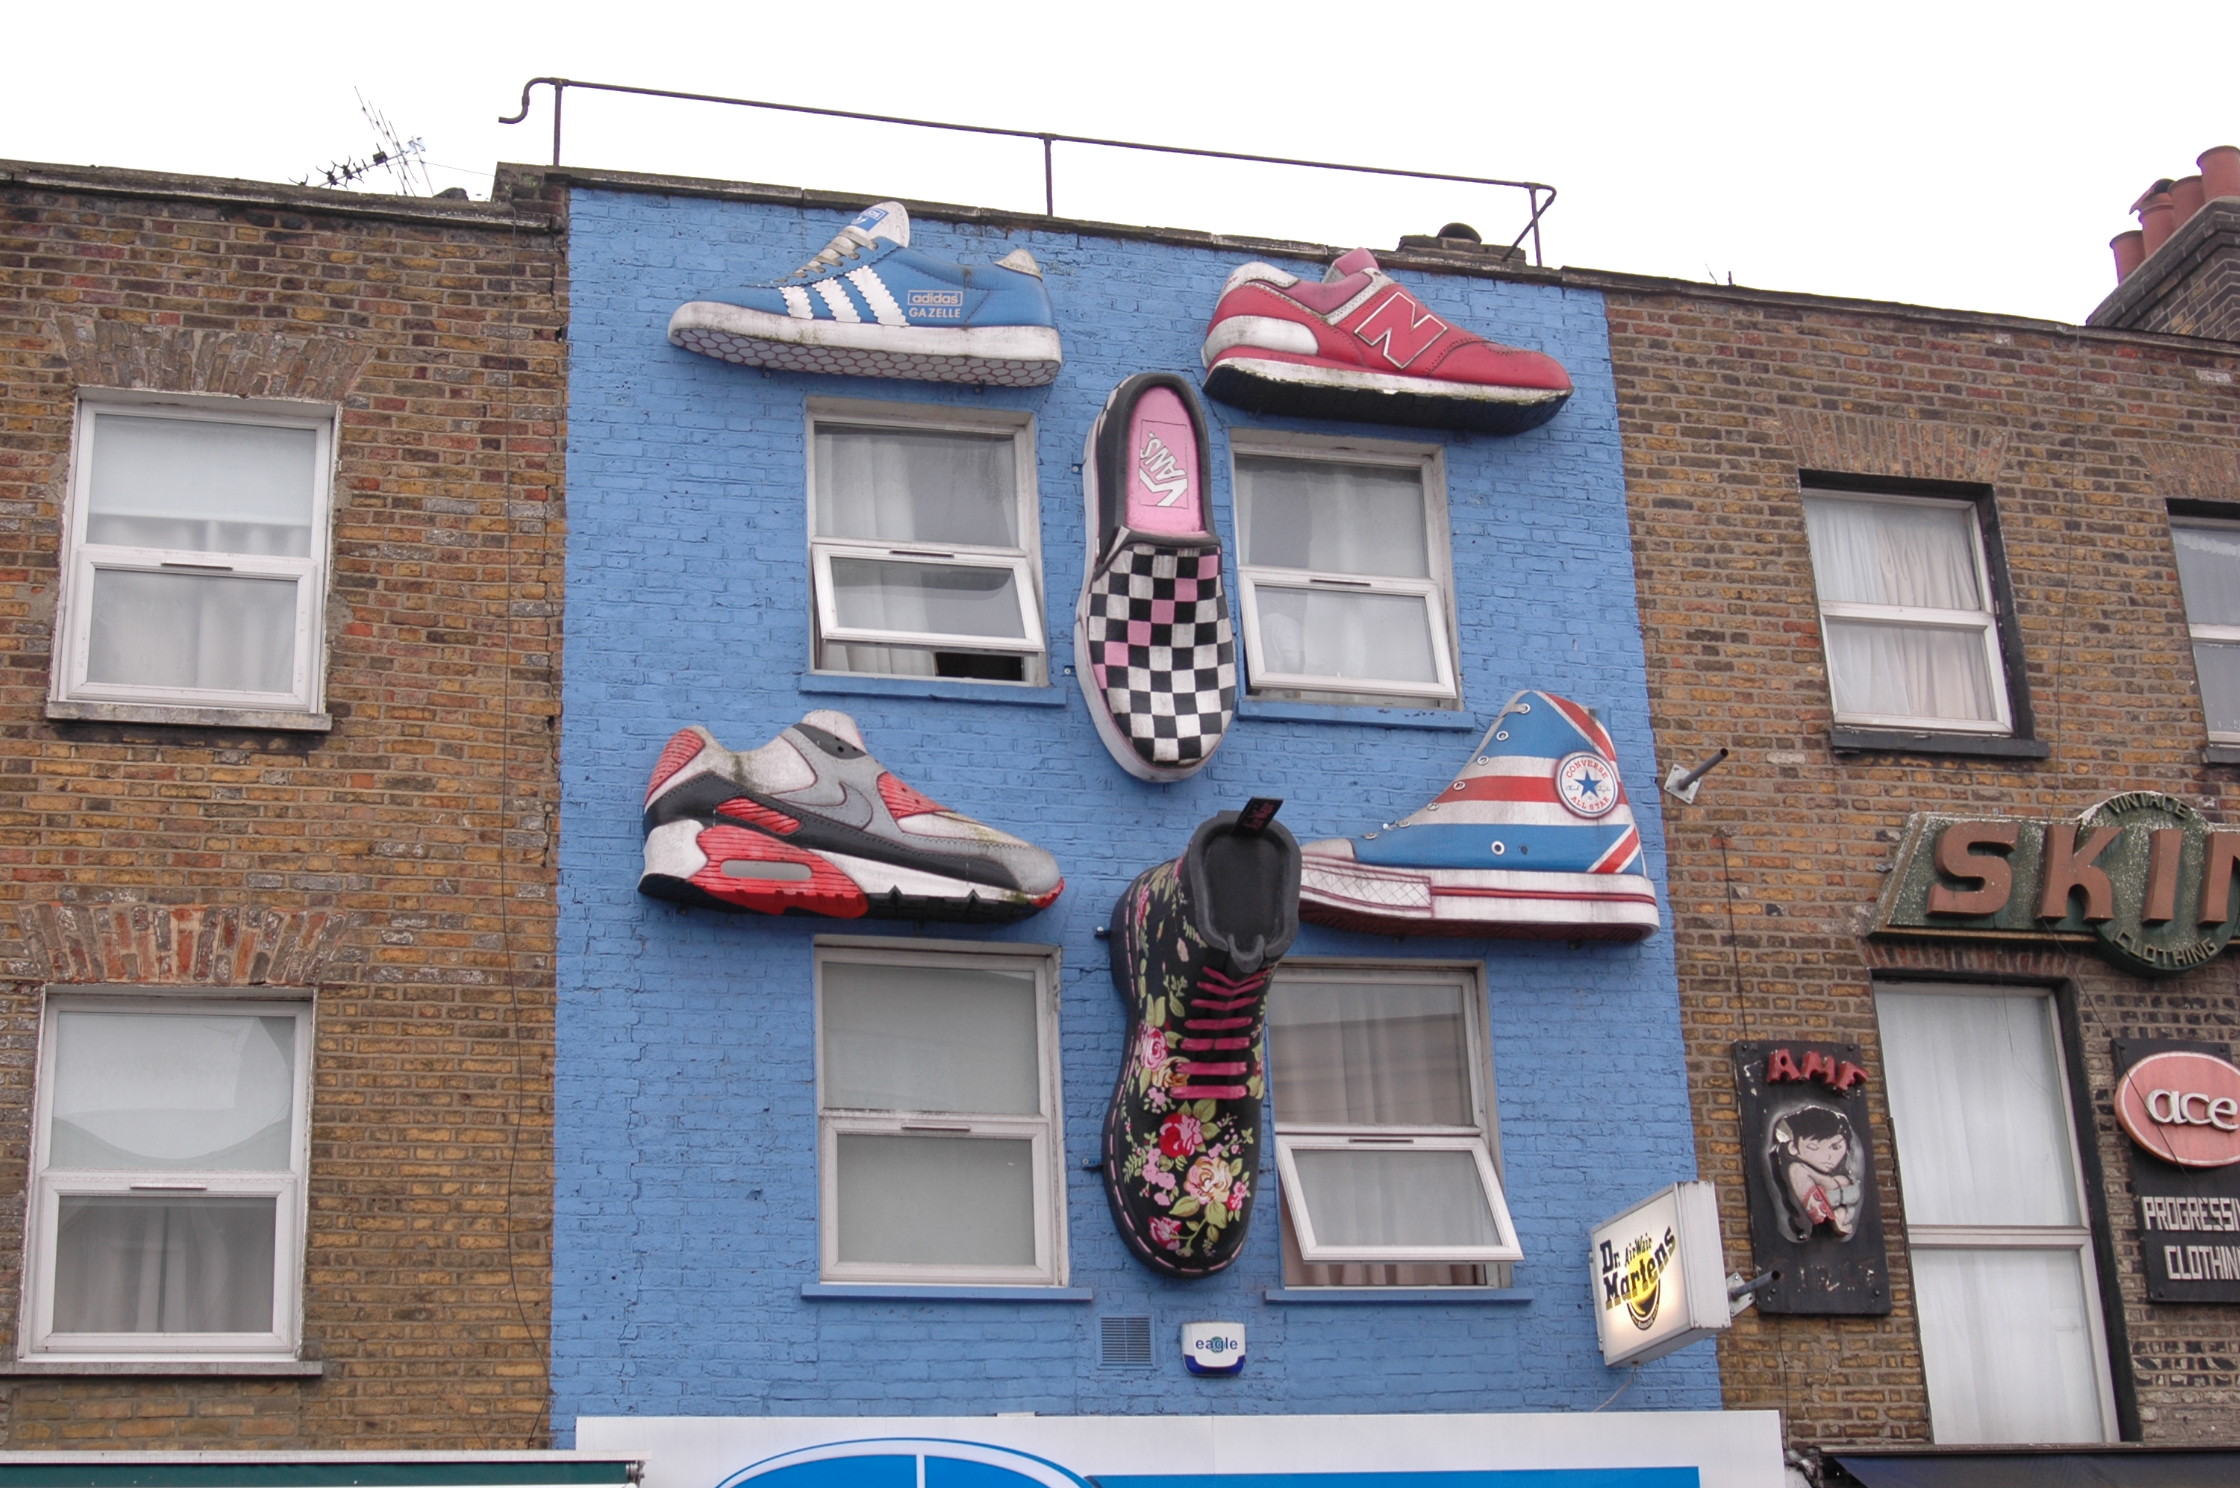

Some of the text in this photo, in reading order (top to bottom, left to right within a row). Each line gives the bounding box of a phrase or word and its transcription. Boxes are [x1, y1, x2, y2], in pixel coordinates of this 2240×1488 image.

[911, 292, 959, 305] adidas
[908, 307, 961, 319] GAZELLE
[1566, 759, 1609, 779] CONVERSE
[1571, 795, 1610, 811] ALL STAR
[2113, 930, 2217, 966] CLOTHING
[2145, 1088, 2240, 1133] ace
[1600, 1239, 1621, 1275] Dr.
[1603, 1226, 1676, 1311] Martens
[2164, 1245, 2240, 1280] CLOTHIN
[1195, 1337, 1238, 1353] eagle
